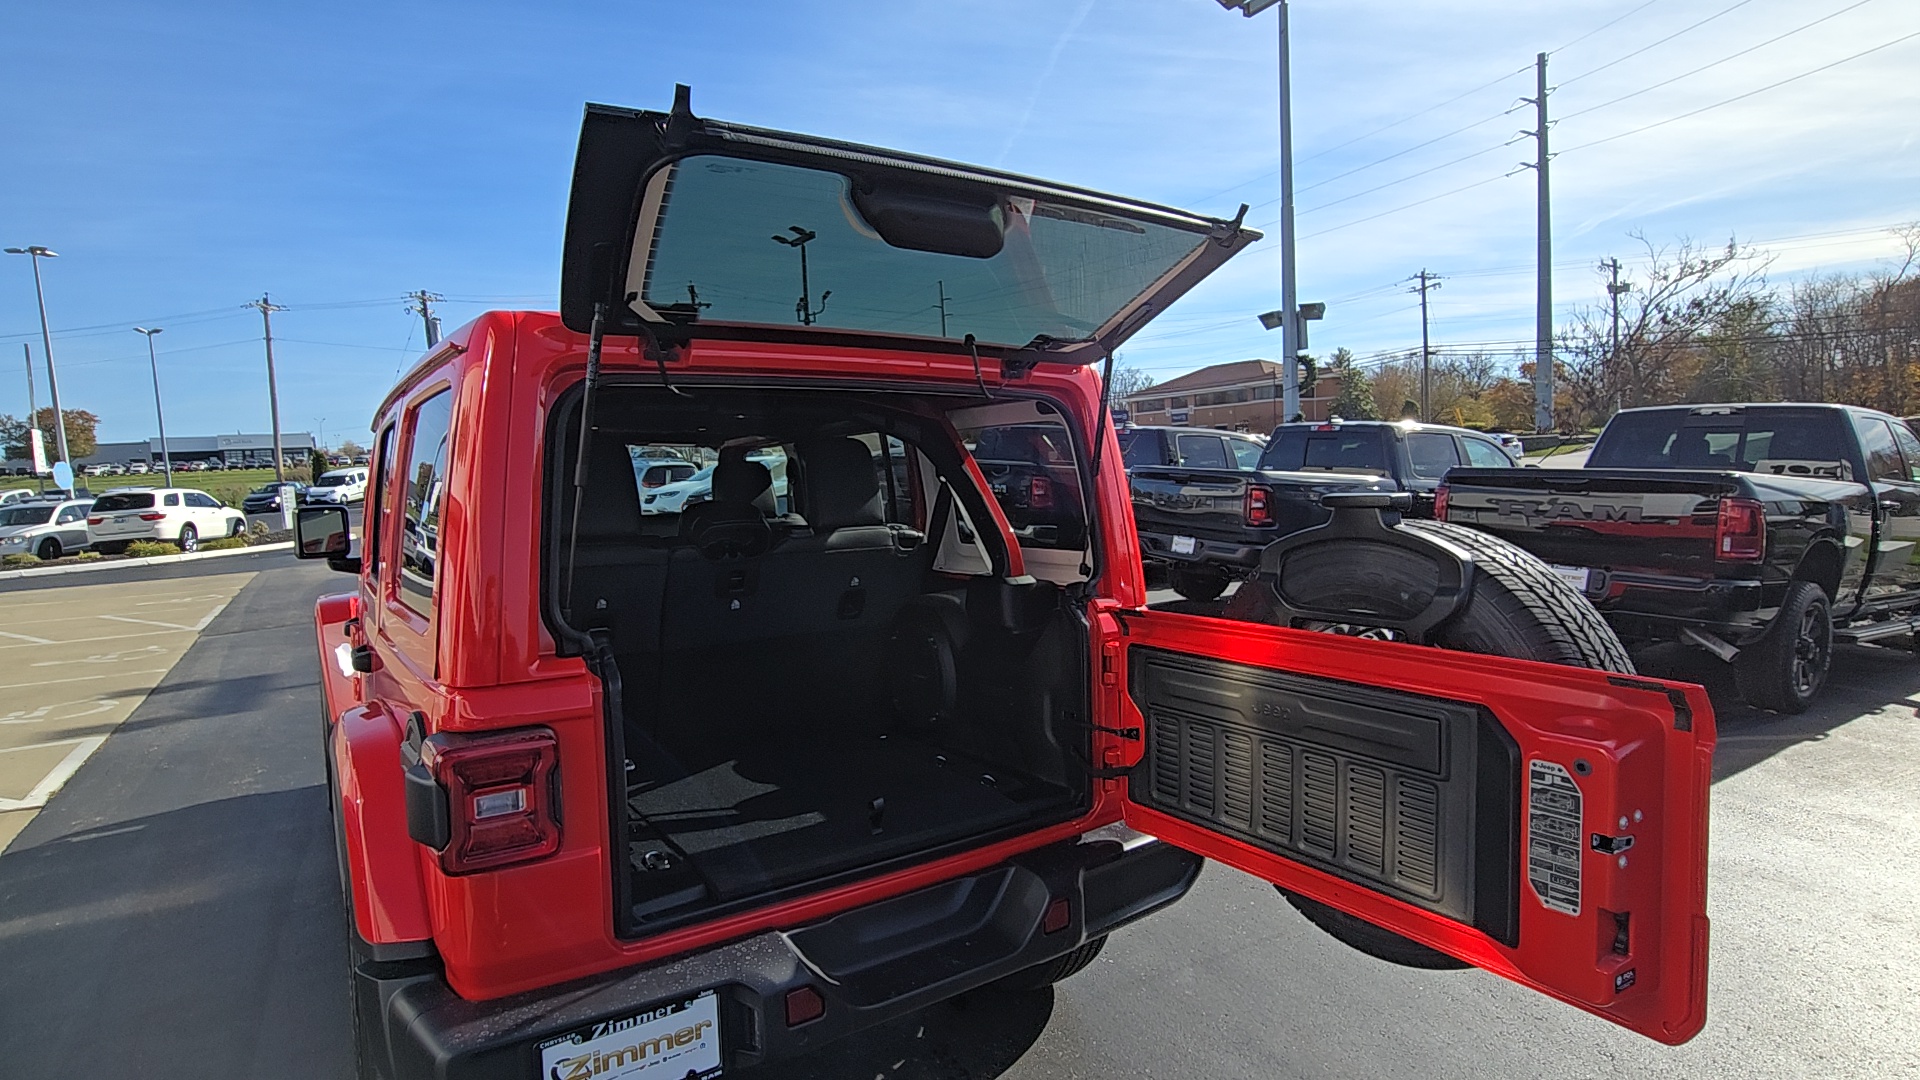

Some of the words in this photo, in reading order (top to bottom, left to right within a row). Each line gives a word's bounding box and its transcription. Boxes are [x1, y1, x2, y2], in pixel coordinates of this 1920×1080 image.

[1498, 501, 1643, 523] RAM
[1251, 702, 1291, 720] Jeep
[1538, 763, 1556, 772] Jeep
[591, 1003, 677, 1041] Zimmer
[540, 1032, 576, 1049] CHRYSLER
[561, 1019, 713, 1080] Zimmer
